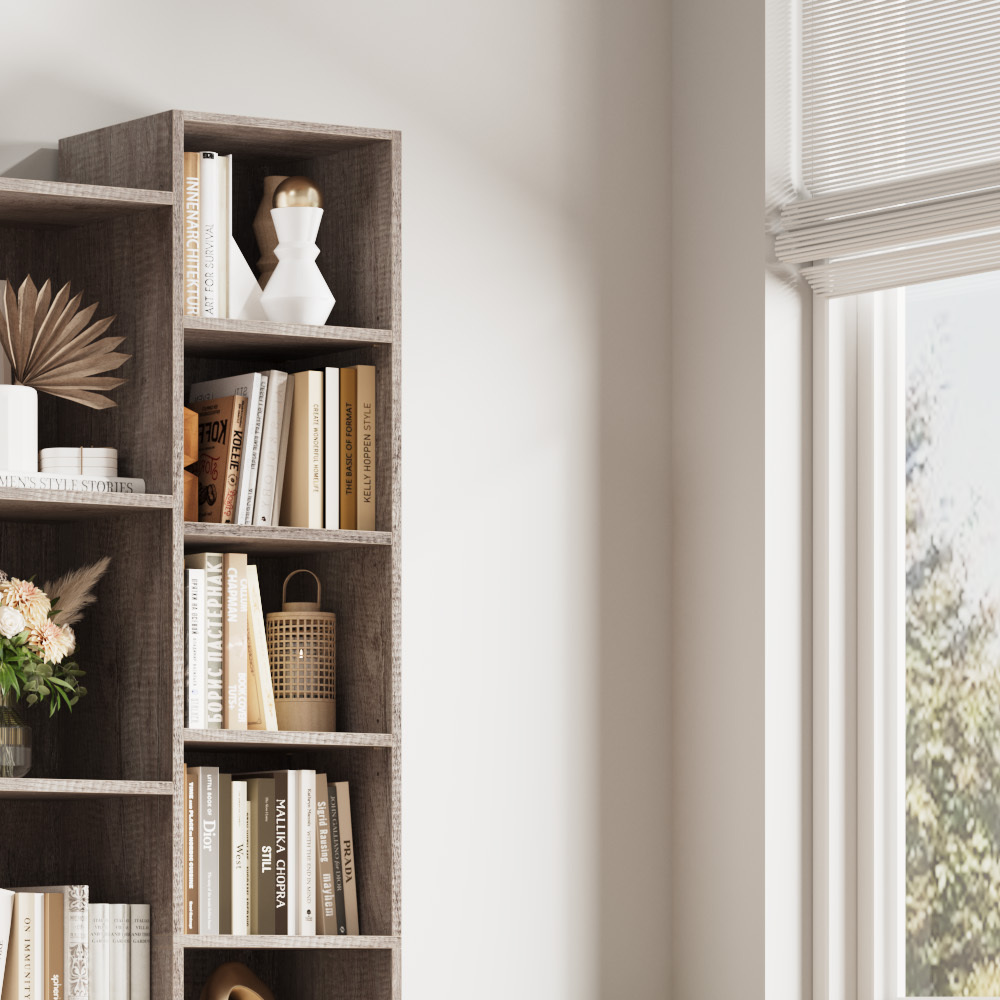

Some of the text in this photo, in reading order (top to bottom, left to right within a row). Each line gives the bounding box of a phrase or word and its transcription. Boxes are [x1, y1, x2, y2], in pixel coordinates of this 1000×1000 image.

[186, 176, 199, 316] INNENARCHITEKTUR
[205, 224, 215, 315] ART FOR SURVIVAL
[347, 442, 352, 451] OF
[40, 477, 79, 492] STYLE
[81, 480, 133, 493] STORIES
[227, 567, 238, 622] CHAPMAN
[207, 561, 223, 723] БОРИС ПАСТЕРНАК
[237, 673, 246, 723] BOOK COVER
[206, 808, 212, 816] OF
[317, 801, 328, 862] Sigrid Rausing
[203, 820, 216, 851] Dior
[236, 844, 244, 870] West
[276, 799, 285, 908] MALLIKA CHOPRA
[331, 819, 339, 859] GALLIANO
[261, 846, 272, 874] STILL
[343, 840, 352, 883] PRADA
[322, 873, 333, 917] mayhem
[24, 918, 31, 932] ON
